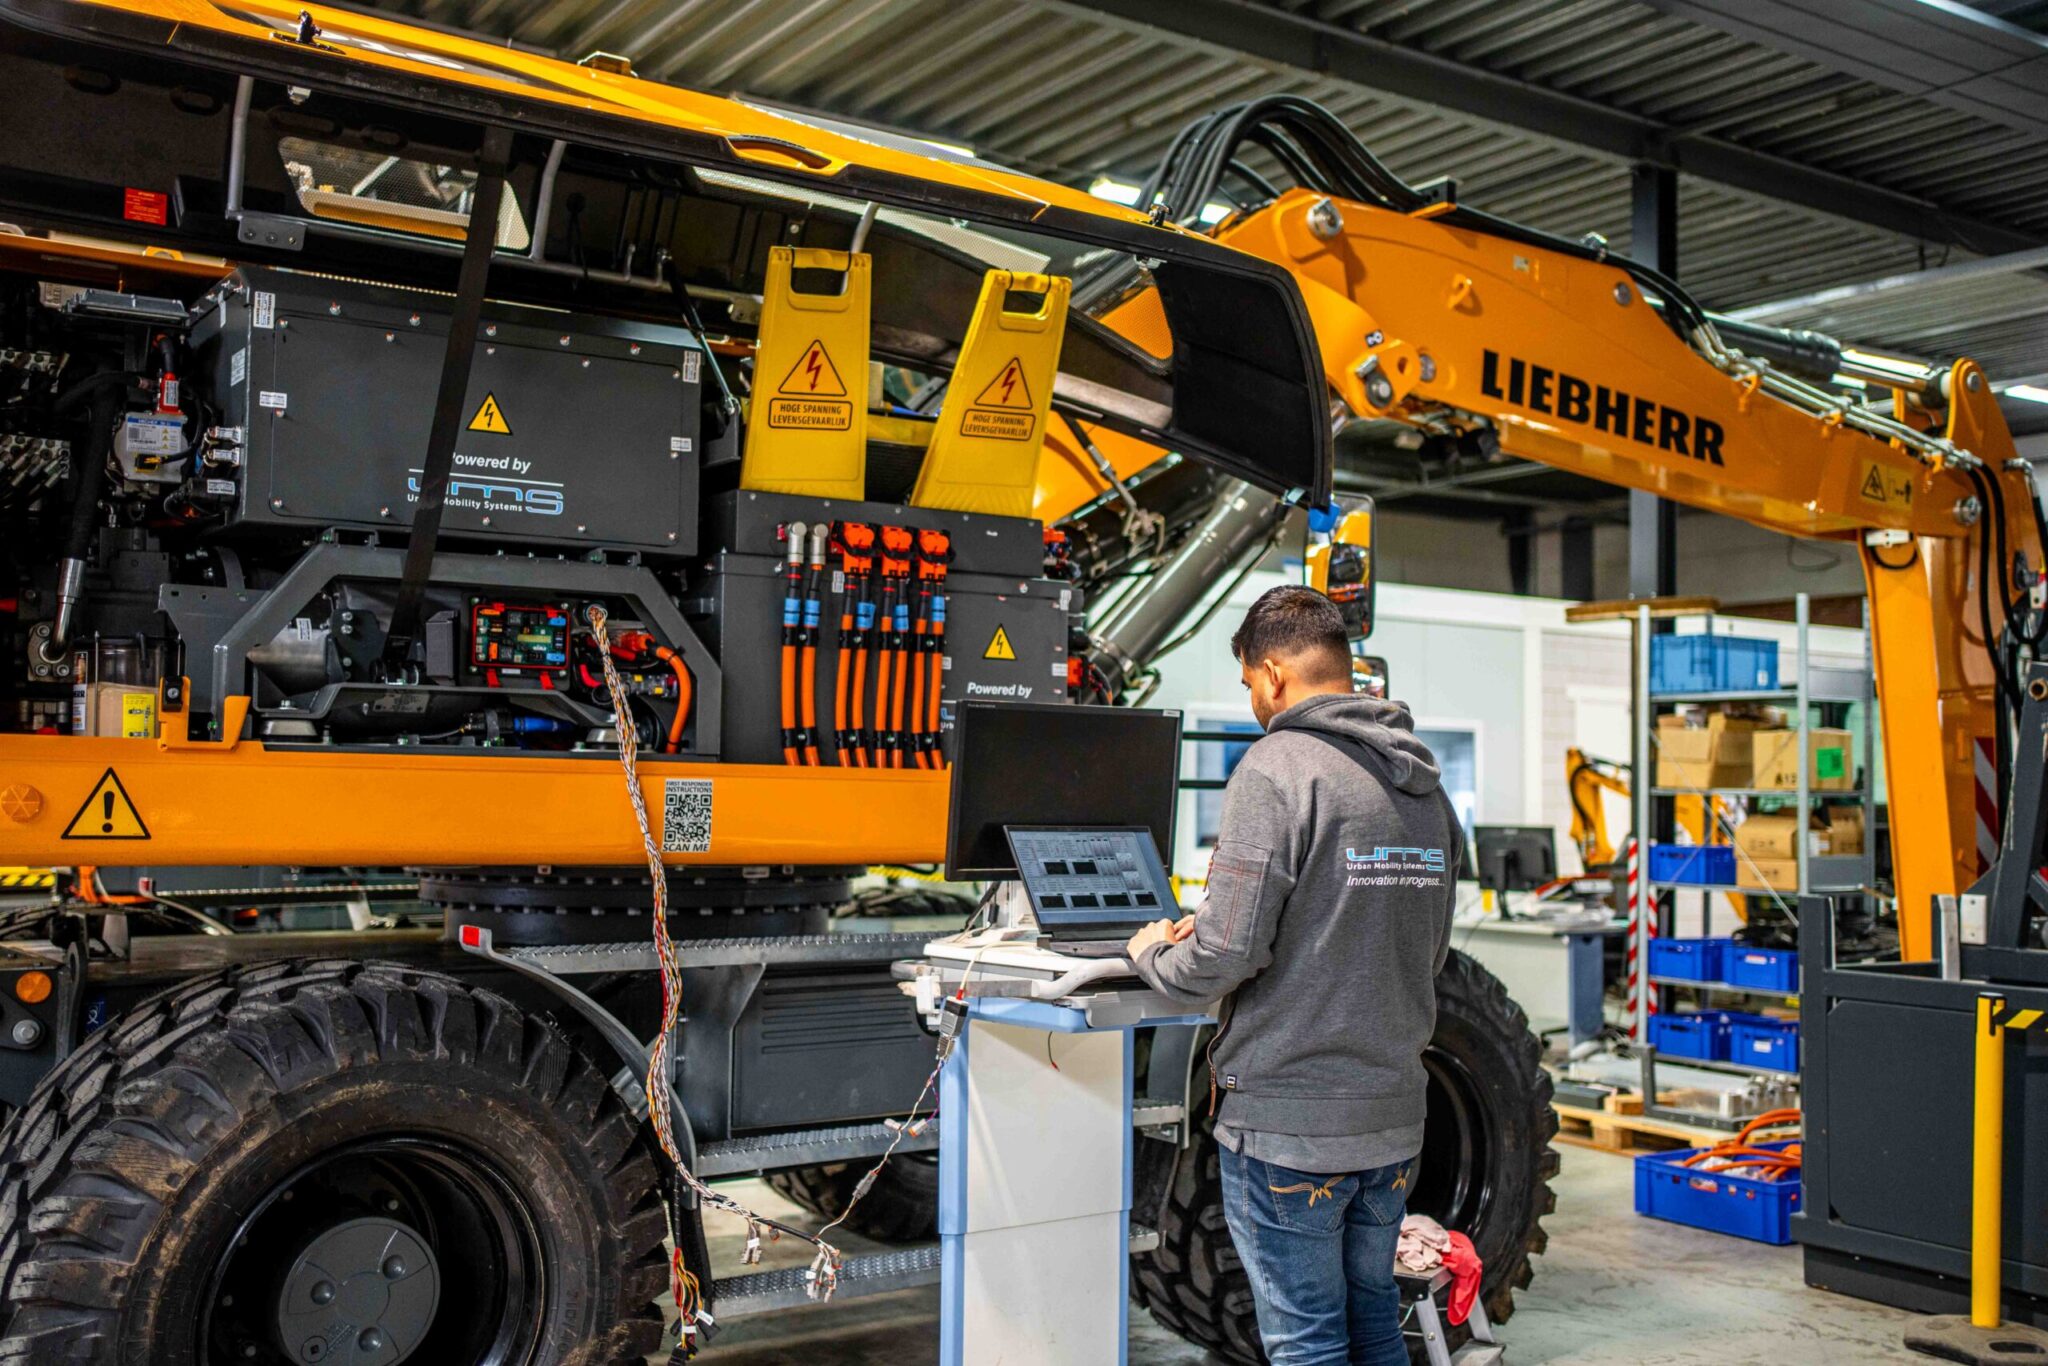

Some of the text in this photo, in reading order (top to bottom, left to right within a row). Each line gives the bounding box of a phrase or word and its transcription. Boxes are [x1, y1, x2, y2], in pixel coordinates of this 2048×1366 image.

[780, 403, 842, 415] HOGE SPANNING
[1481, 348, 1726, 468] LIEBHERR
[773, 414, 846, 426] LEVENSGEVAARLIJK
[993, 415, 1026, 426] SPANNING
[512, 458, 531, 474] by
[484, 501, 523, 512] Systems
[966, 681, 1032, 699] Powered by
[663, 843, 709, 852] SCAN ME
[1346, 862, 1372, 870] Urban
[1374, 862, 1401, 871] Mobility
[1346, 875, 1398, 887] Innovation
